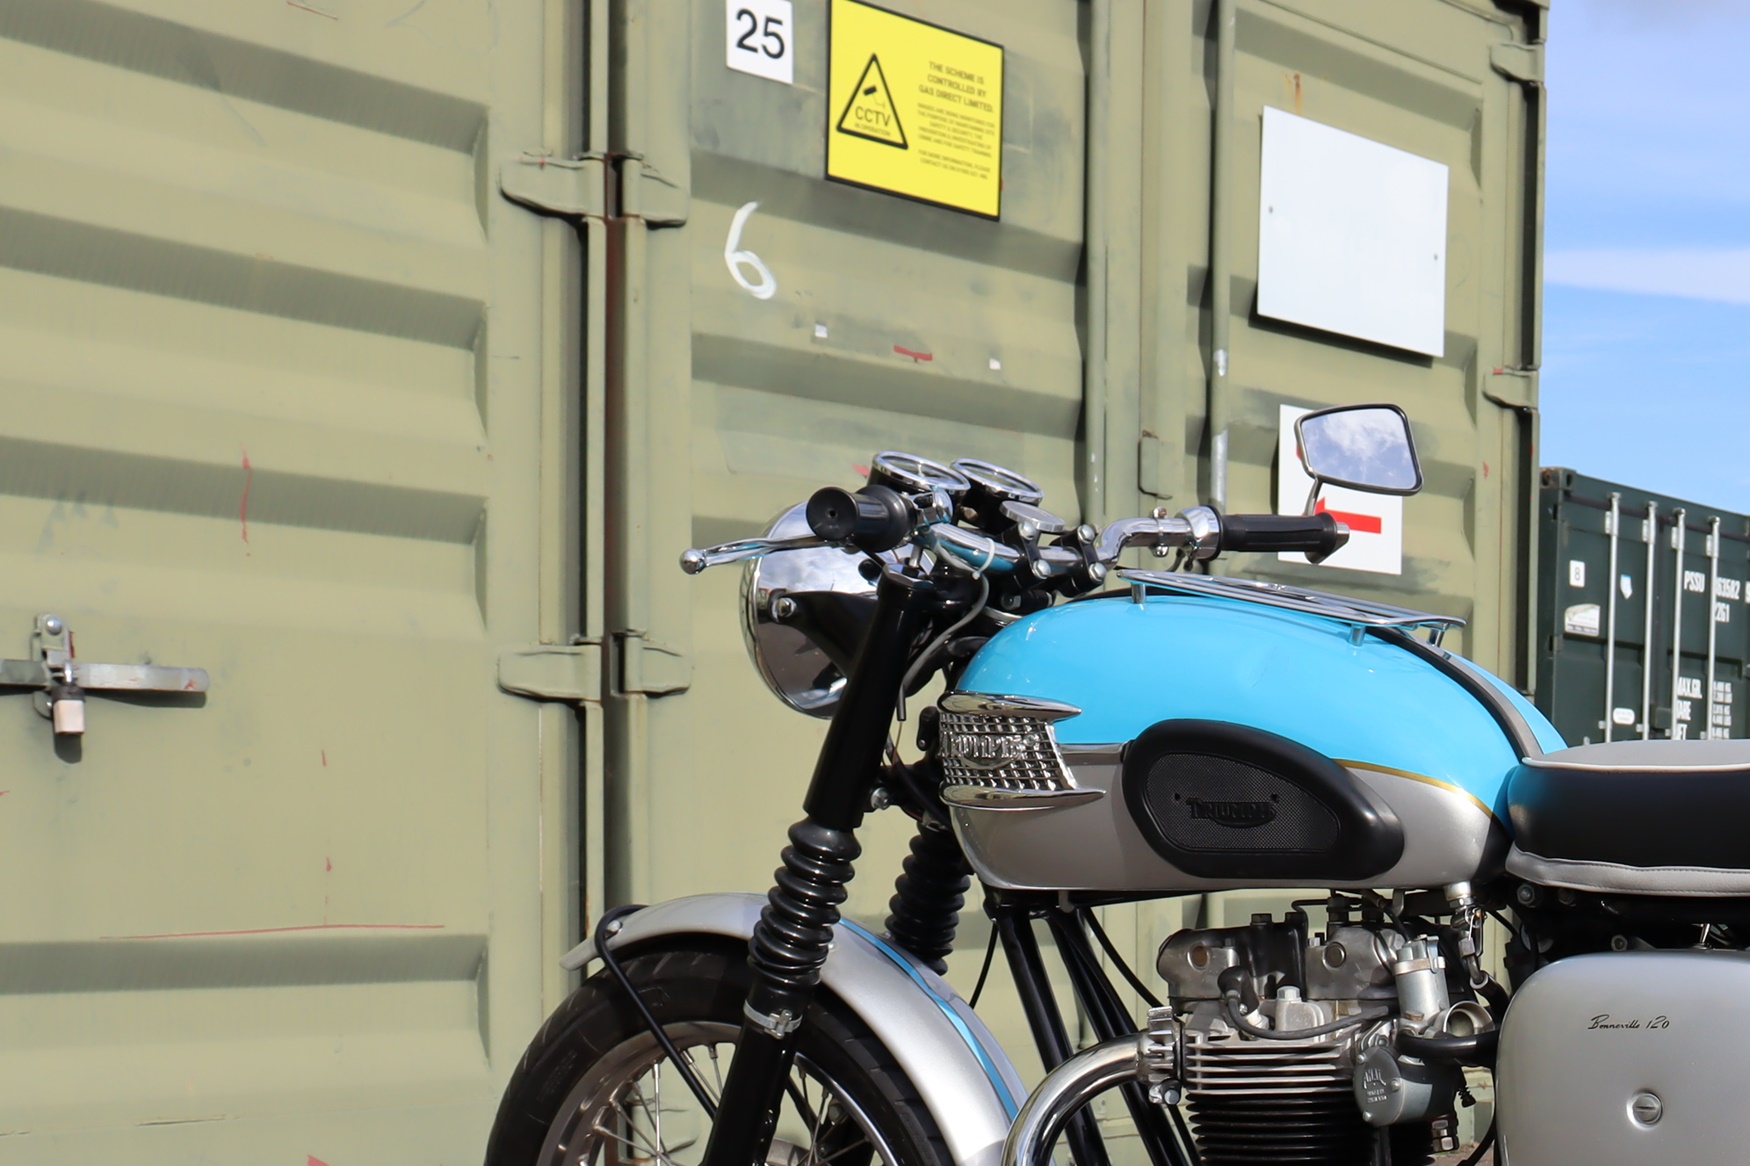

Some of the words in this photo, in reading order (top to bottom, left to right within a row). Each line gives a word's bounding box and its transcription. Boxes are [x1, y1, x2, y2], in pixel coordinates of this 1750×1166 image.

[736, 8, 785, 60] 25
[929, 61, 944, 74] THE
[945, 66, 976, 82] SCHEME
[976, 74, 985, 86] IS
[918, 84, 935, 97] GAS
[936, 88, 963, 105] DIRECT
[927, 74, 977, 95] CONTROLLED
[976, 87, 987, 98] BY
[855, 106, 891, 127] CCTV
[724, 201, 777, 300] 6
[1574, 565, 1581, 581] 8
[1185, 797, 1276, 825] TRIUMPH
[1588, 1014, 1641, 1030] Bonneville
[1645, 1015, 1670, 1029] 120
